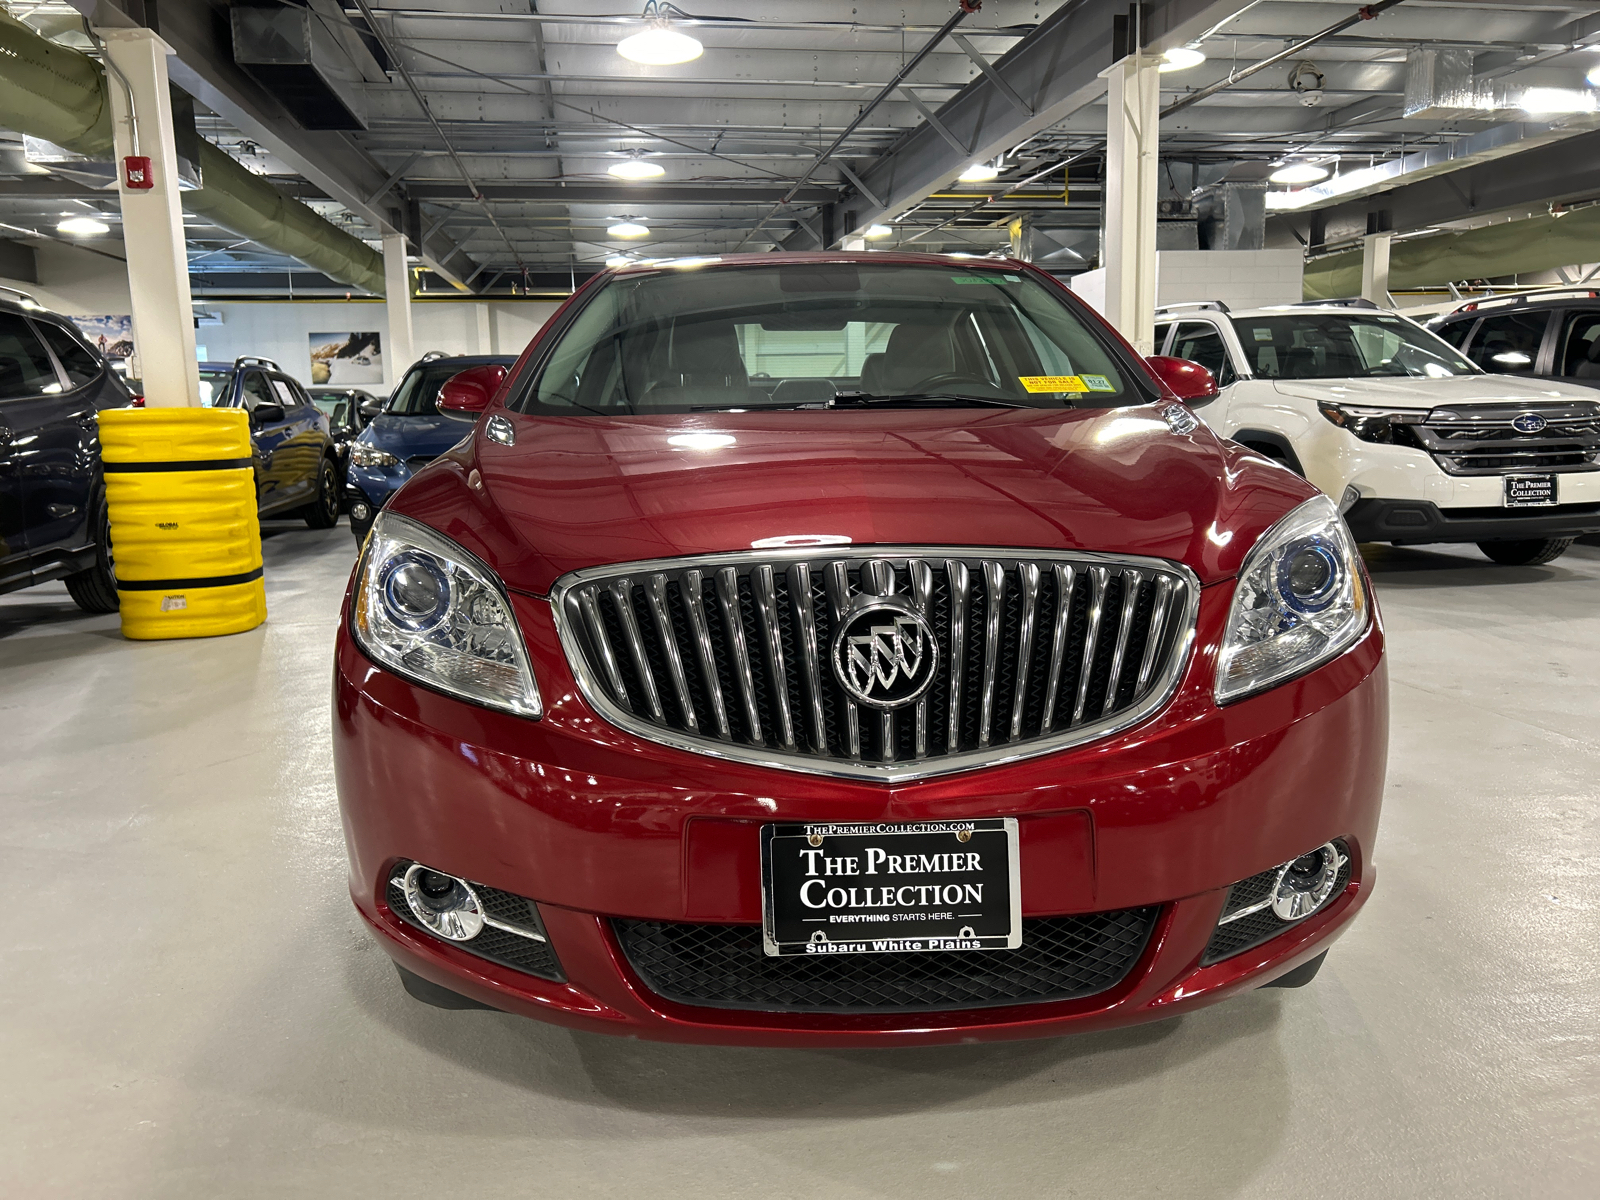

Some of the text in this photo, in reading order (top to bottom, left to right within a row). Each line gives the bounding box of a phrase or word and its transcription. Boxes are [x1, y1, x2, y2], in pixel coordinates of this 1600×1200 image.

[1510, 489, 1551, 497] COLLECTION
[799, 847, 983, 877] THE PREMIER
[799, 879, 984, 909] COLLECTION
[829, 912, 955, 923] EVERYTHING STARTS HERE.
[805, 939, 982, 954] Subaru White Plains
